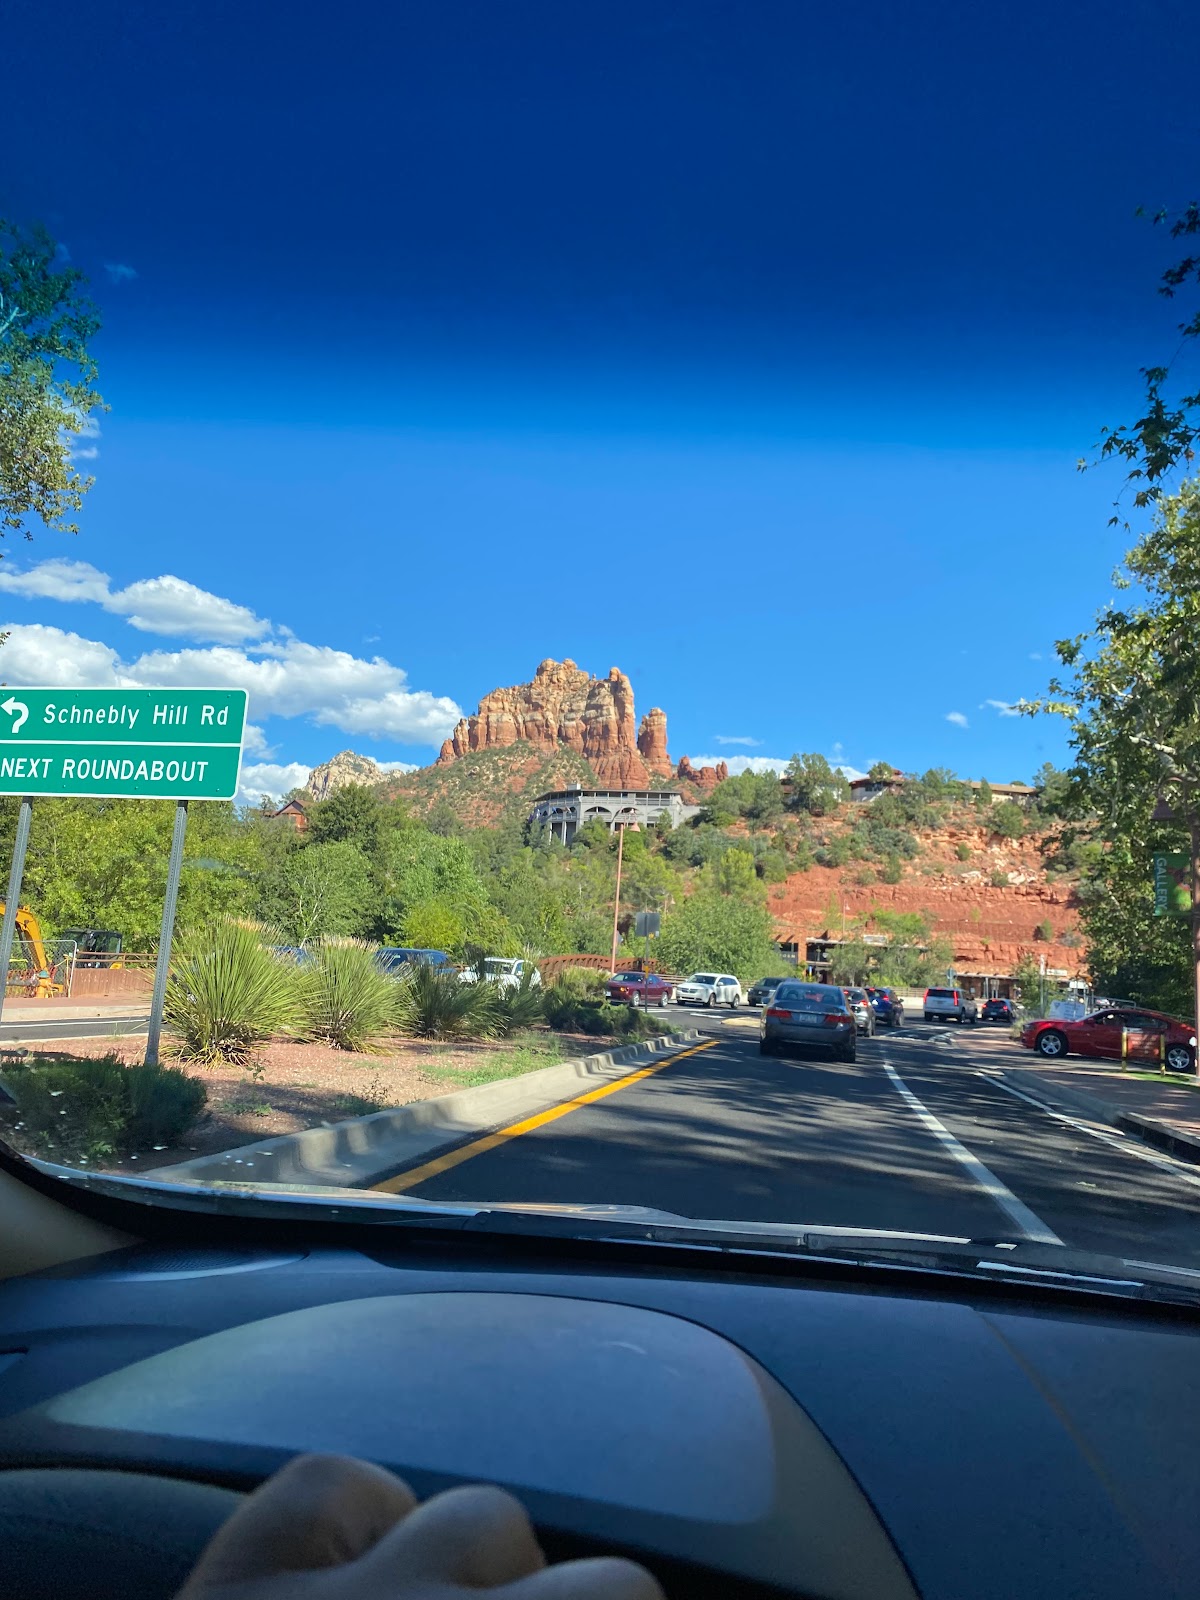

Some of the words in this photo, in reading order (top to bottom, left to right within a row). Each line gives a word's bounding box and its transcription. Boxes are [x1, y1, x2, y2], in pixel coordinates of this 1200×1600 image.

[43, 703, 140, 729] Schnebly
[152, 704, 188, 725] Hill
[200, 704, 229, 726] Rd
[0, 757, 53, 779] NEXT
[61, 758, 209, 782] ROUNDABOUT
[1156, 857, 1168, 910] GALLERY
